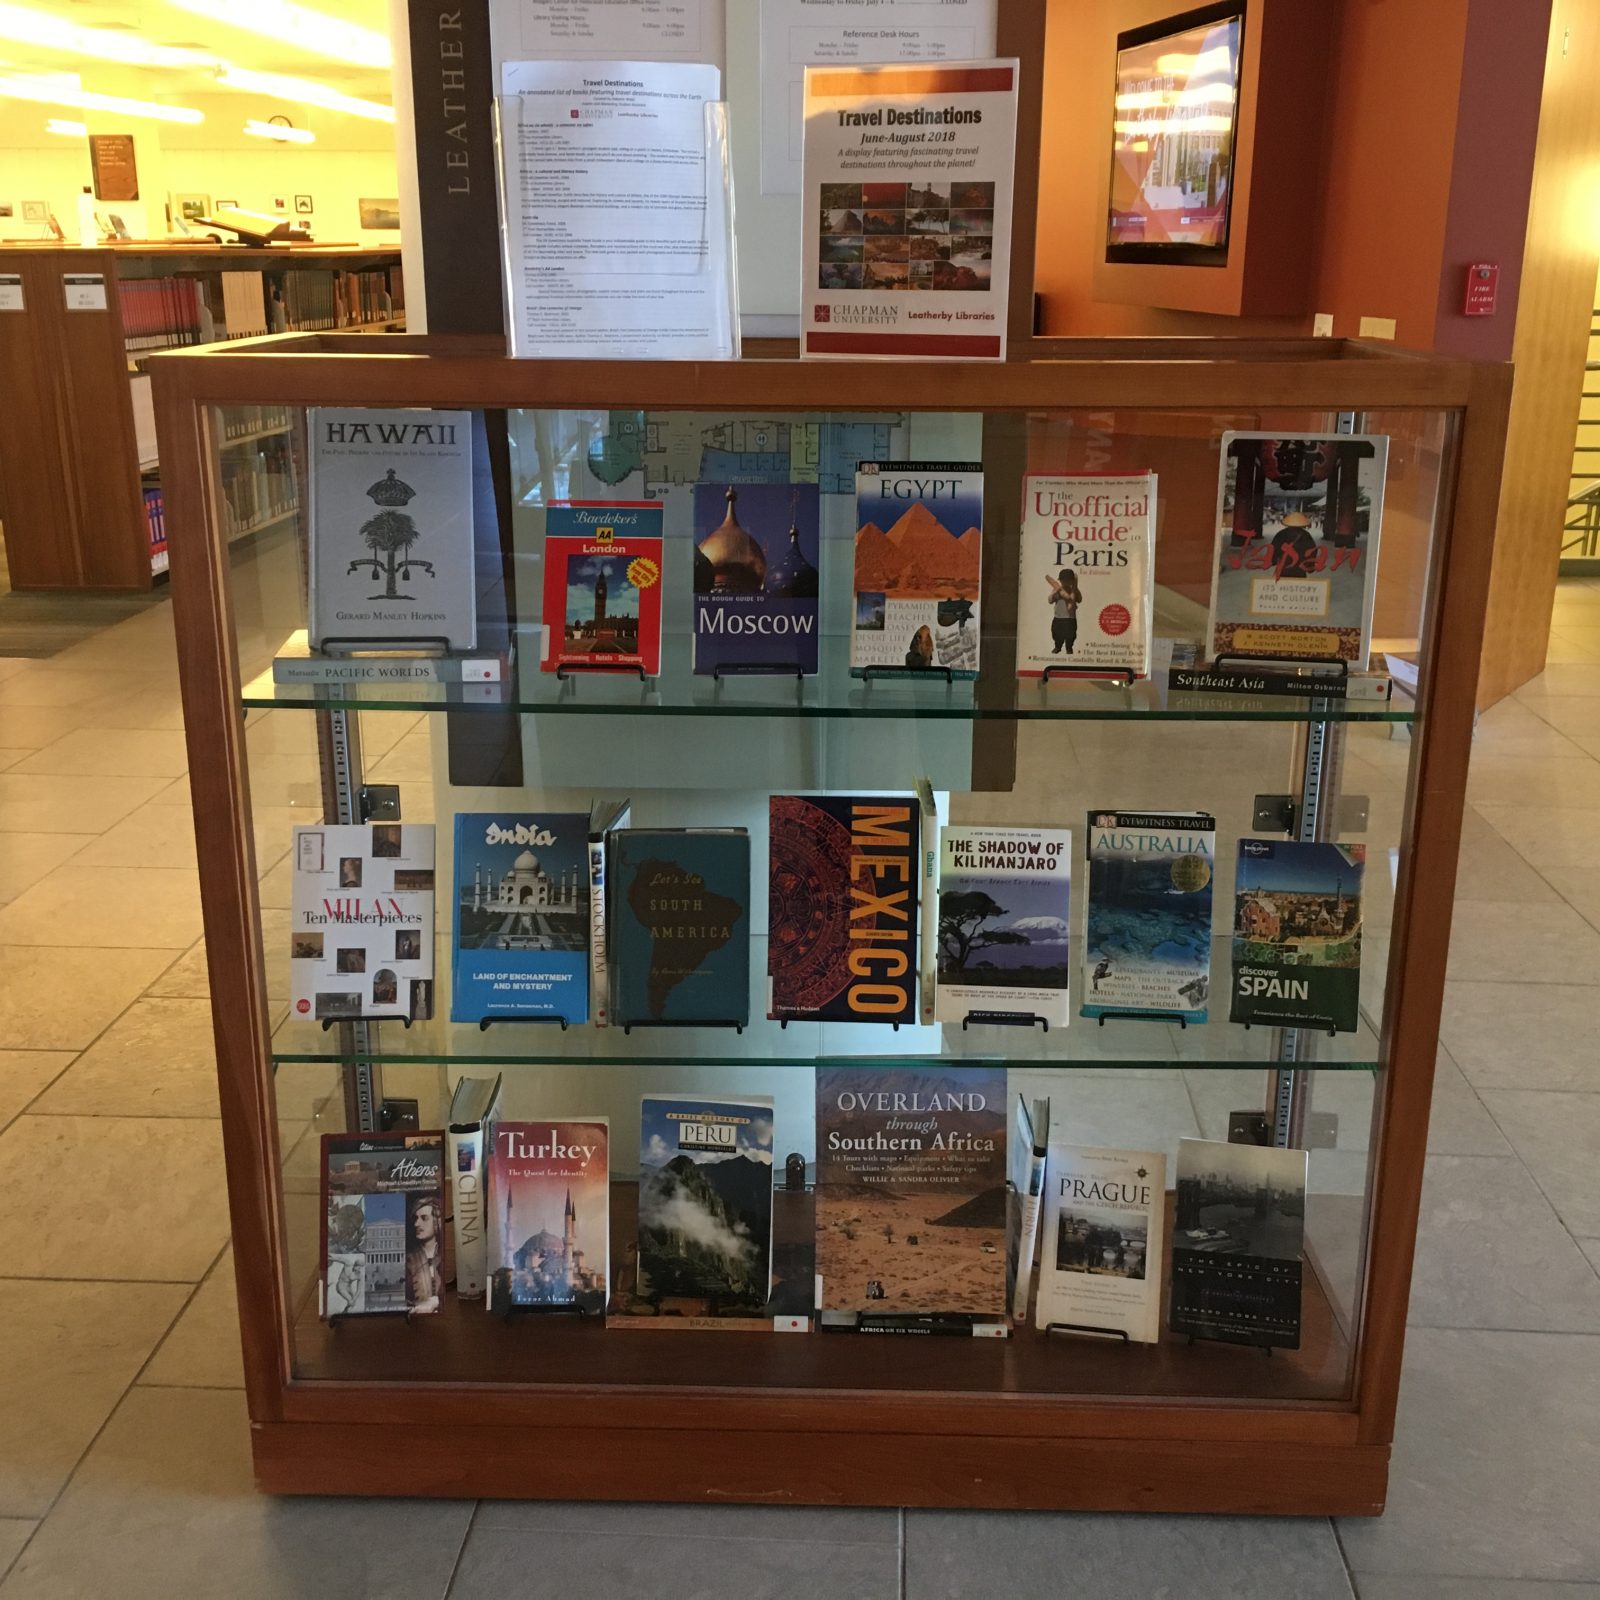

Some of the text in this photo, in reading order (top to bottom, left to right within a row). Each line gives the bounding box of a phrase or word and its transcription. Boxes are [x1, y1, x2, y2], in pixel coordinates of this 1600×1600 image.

[843, 30, 920, 38] Reference Desk Hours
[583, 79, 644, 88] Travel Destinations
[439, 8, 470, 195] LEATHER
[837, 106, 982, 127] Travel Destinations
[860, 131, 956, 145] June-August 2018
[838, 146, 979, 159] A display featuring fascinating travel
[840, 158, 976, 170] destinations throughout the planet!
[833, 304, 899, 316] CHAPMAN
[833, 311, 995, 325] UNIVERSITY Leatherby Libraries
[326, 422, 457, 445] HAWAII
[880, 479, 963, 500] EGYPT
[1034, 490, 1149, 518] Unofficial
[598, 530, 612, 540] AA
[1052, 519, 1127, 541] Guide
[582, 544, 626, 554] London
[1053, 541, 1129, 567] Paris
[1226, 528, 1362, 584] Japan
[1279, 585, 1318, 593] HISTORY
[1259, 594, 1320, 603] AND CULTURE
[325, 667, 430, 679] PACIFIC WORLDS
[1176, 673, 1236, 689] Southeast
[1238, 676, 1265, 690] Asia
[1120, 817, 1176, 828] EYEWITNESS
[1179, 818, 1211, 829] TRAVEL
[947, 839, 1064, 856] THE SHADOW OF
[1096, 833, 1209, 854] AUSTRALIA
[926, 851, 935, 879] Ghana
[954, 854, 1058, 871] KILIMANJARO
[322, 898, 405, 921] MILAN
[650, 899, 703, 911] SOUTH
[847, 805, 911, 1014] MEXICO
[303, 910, 423, 927] Ten Masterpieces
[592, 888, 606, 974] STOCKHOLM
[651, 926, 730, 938] AMERICA
[472, 973, 573, 982] LAND OF ENCHANTMENT
[1239, 965, 1279, 977] discover
[493, 982, 553, 991] AND MYSTERY
[1238, 976, 1309, 1001] SPAIN
[837, 1091, 987, 1112] OVERLAND
[886, 1116, 938, 1135] through
[684, 1125, 732, 1144] PERU
[828, 1131, 996, 1152] Southern Africa
[499, 1129, 598, 1168] Turkey
[390, 1157, 439, 1178] Athens
[1059, 1178, 1151, 1206] PRAGUE
[457, 1174, 479, 1246] CHINA
[689, 1319, 724, 1328] BRAZIL
